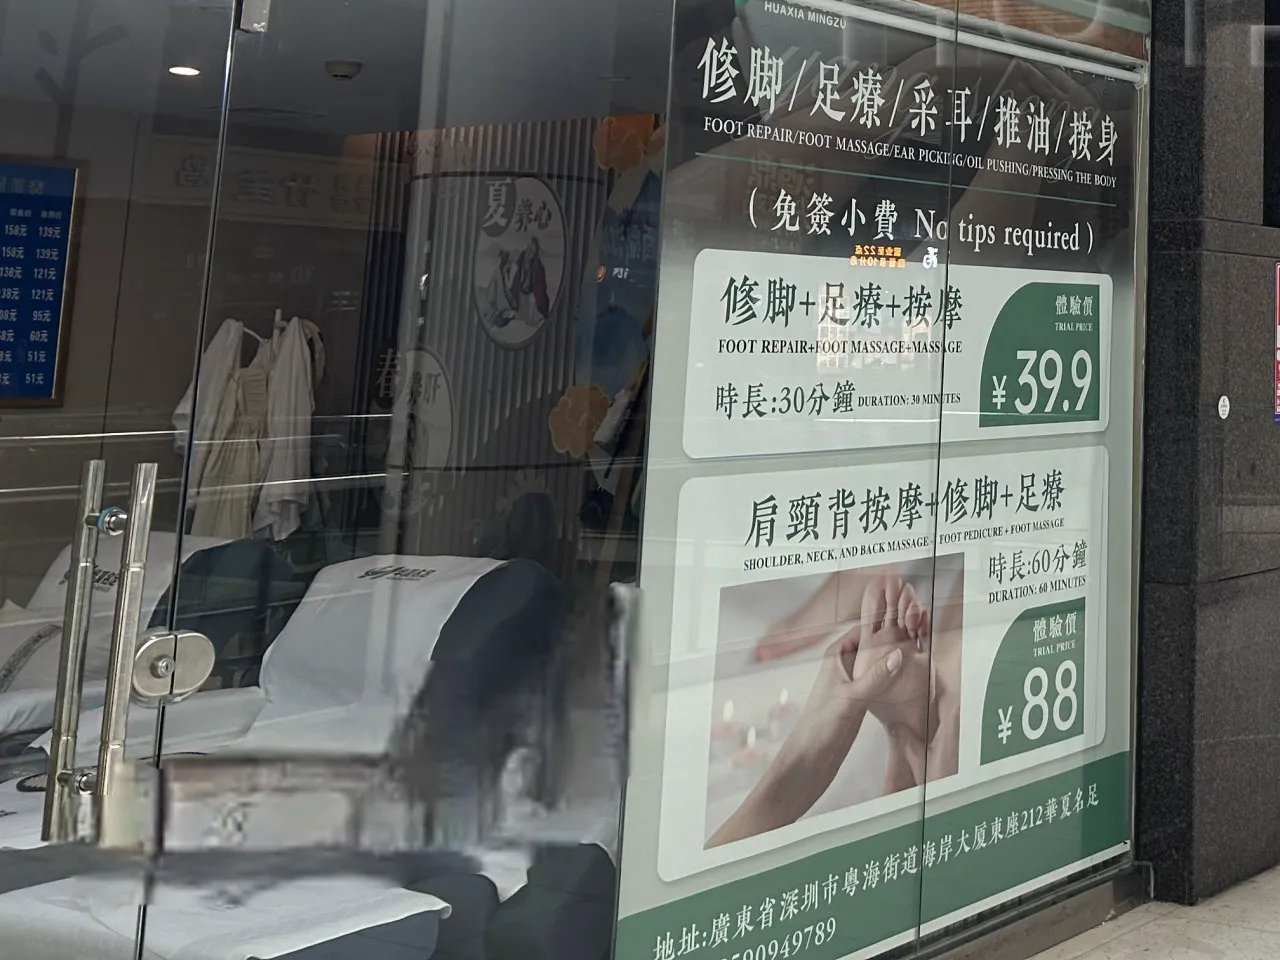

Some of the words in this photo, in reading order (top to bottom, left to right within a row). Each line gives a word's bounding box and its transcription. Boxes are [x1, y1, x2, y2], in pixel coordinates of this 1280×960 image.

[764, 0, 804, 20] HUAXIA
[808, 10, 847, 29] MINGZU
[704, 116, 742, 134] FOOT
[747, 121, 831, 149] REPAIR/FOOT
[836, 136, 914, 161] MASSAGE/EAR
[987, 157, 1072, 183] PUSHING/PRESSING
[1075, 170, 1092, 186] THE
[1094, 172, 1117, 188] BODY
[482, 178, 512, 229] 夏
[914, 208, 947, 239] No
[959, 213, 995, 245] tips
[1055, 321, 1074, 331] TRIAL
[1076, 321, 1093, 332] PRICE
[719, 338, 757, 354] FOOT
[761, 339, 847, 355] REPAIR+FOOT
[858, 393, 909, 408] DURATION:
[912, 393, 921, 406] 30
[922, 392, 961, 405] MINUTES
[744, 555, 804, 571] SHOULDER,
[840, 546, 858, 560] AND
[860, 543, 885, 557] BACK
[887, 538, 929, 554] MASSAGE
[939, 531, 962, 544] FOOT
[963, 526, 1002, 541] PEDICURE
[1011, 522, 1032, 535] FOOT
[1033, 517, 1064, 532] MASSAGE
[988, 586, 1036, 604] DURATION:
[1038, 582, 1047, 594] 60
[1049, 576, 1086, 592] MINUTES
[1033, 644, 1055, 657] TRIAL
[1057, 640, 1076, 653] PRICE
